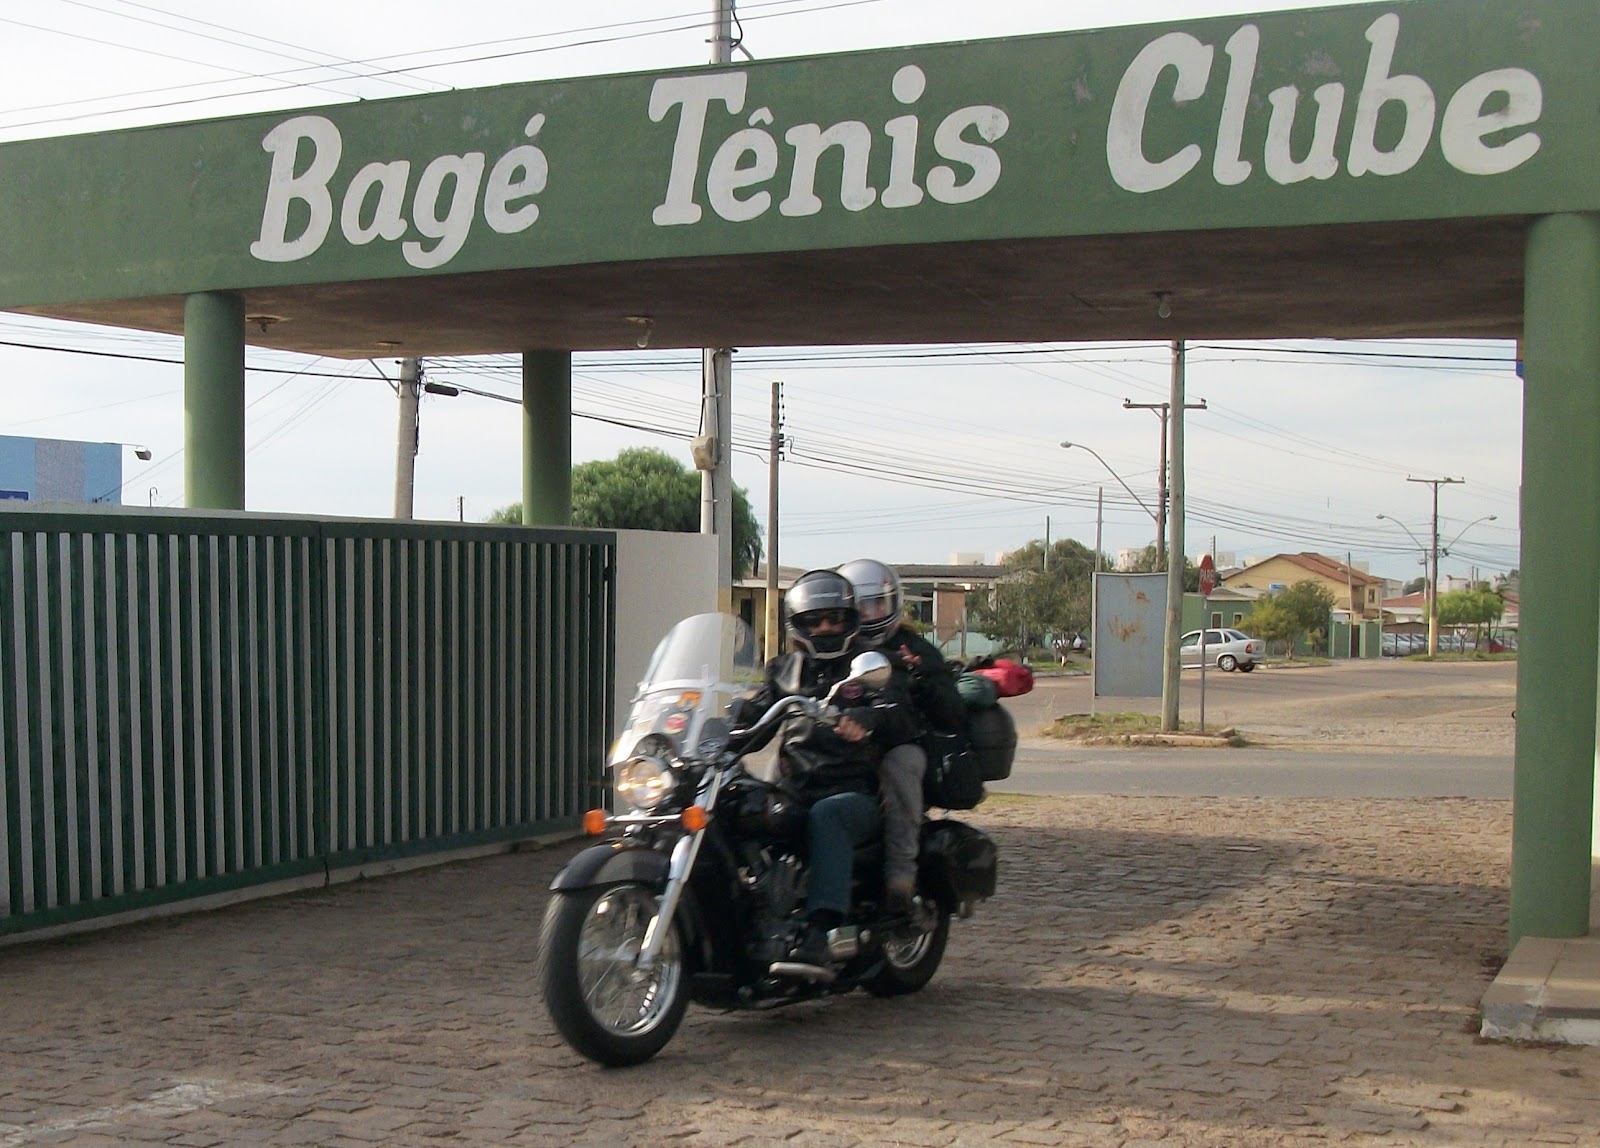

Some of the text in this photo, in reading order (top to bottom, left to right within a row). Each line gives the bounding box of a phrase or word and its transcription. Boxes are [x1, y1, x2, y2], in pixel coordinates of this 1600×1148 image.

[249, 13, 1543, 269] Bagé Tênis Clube
